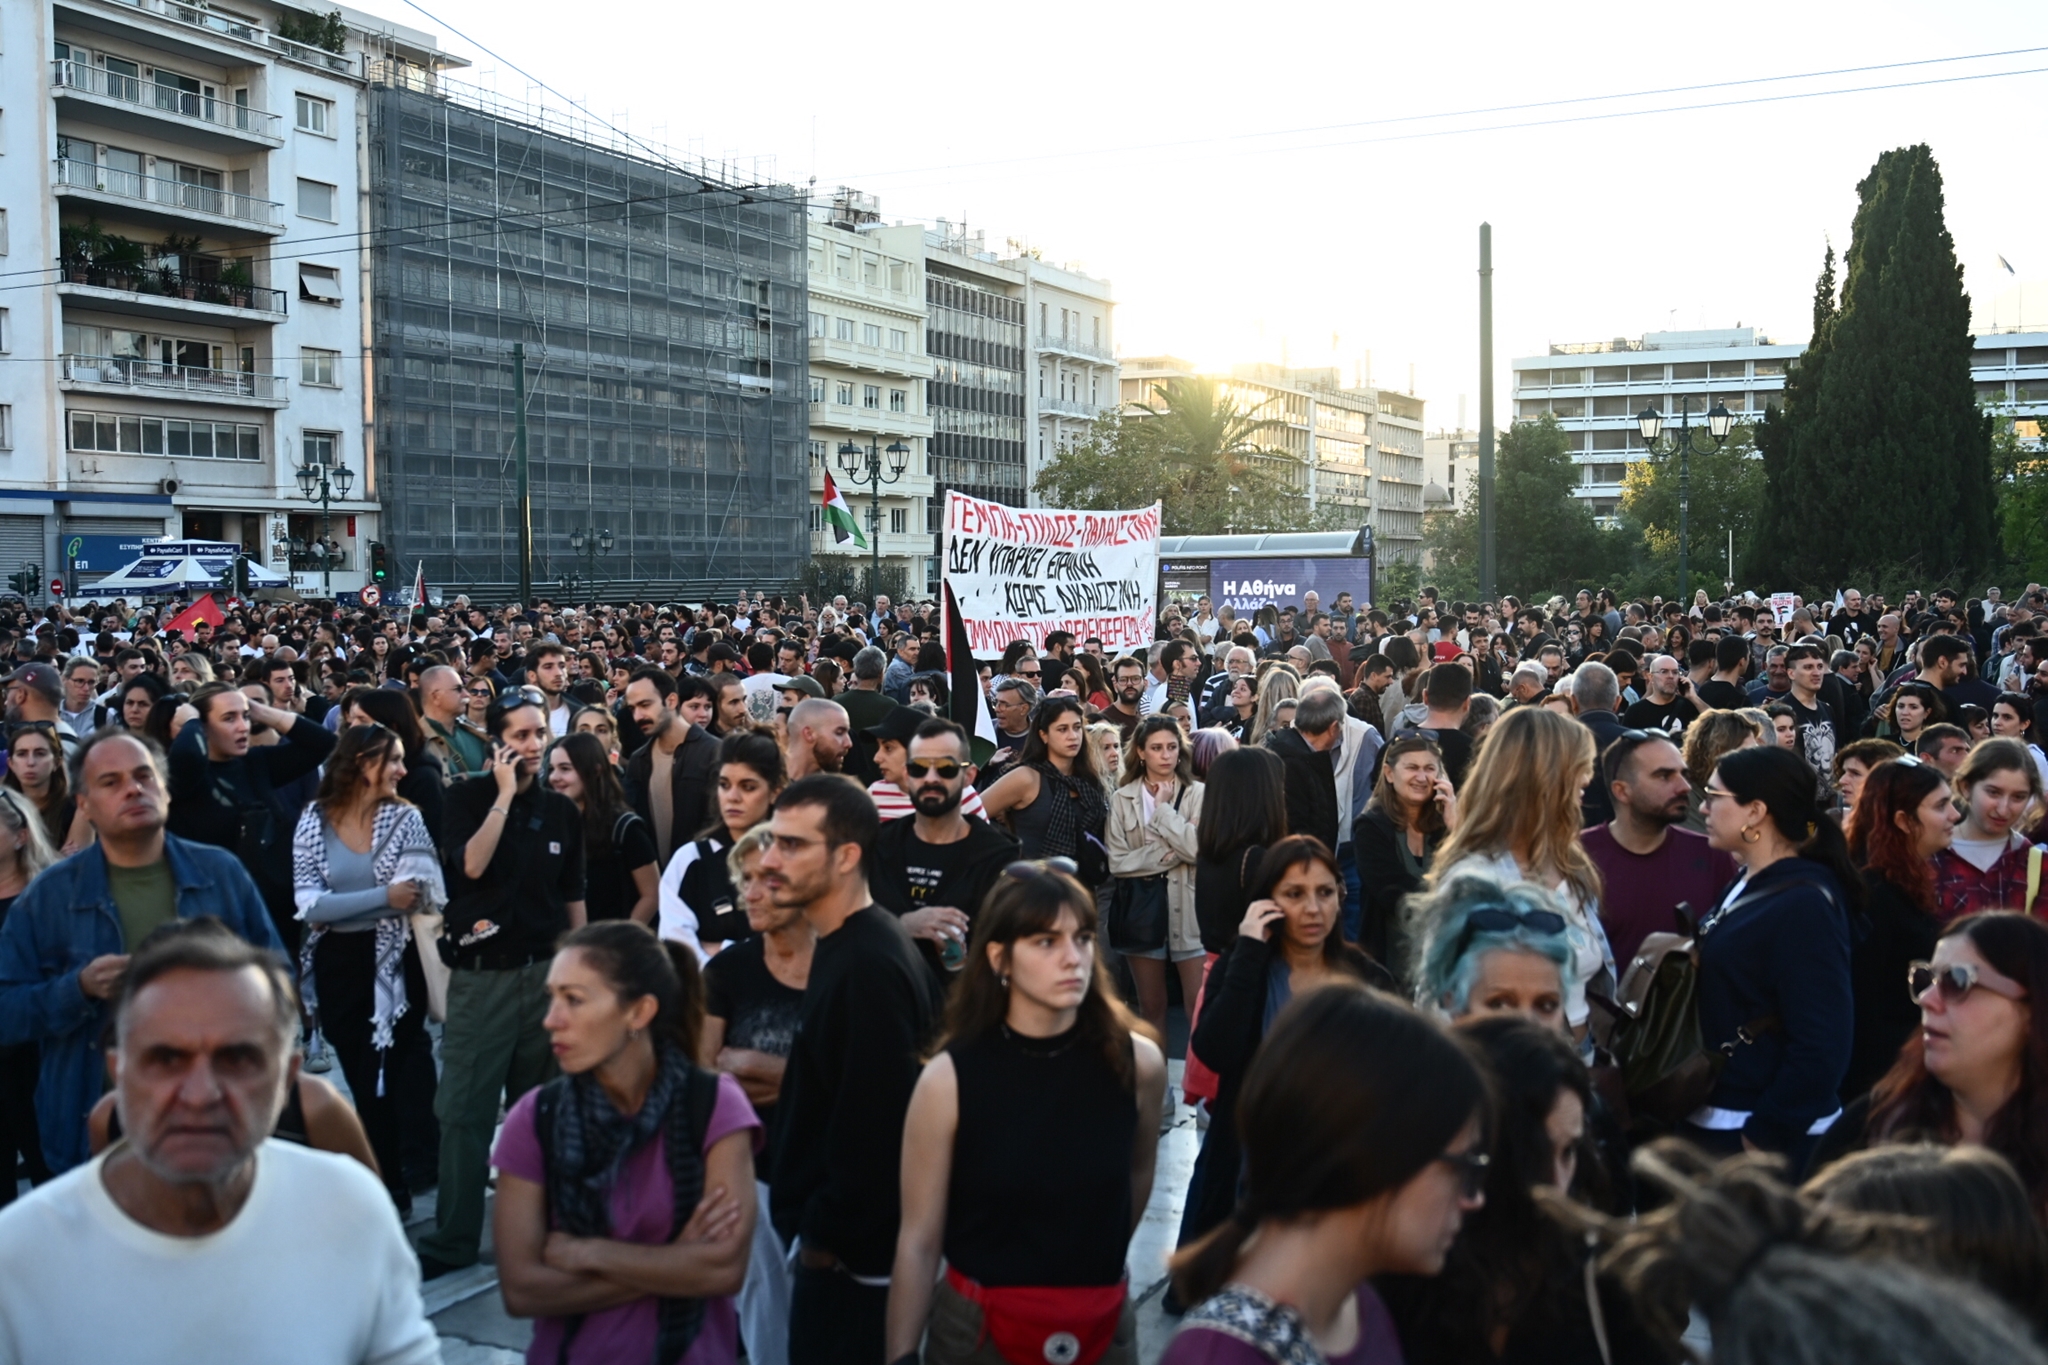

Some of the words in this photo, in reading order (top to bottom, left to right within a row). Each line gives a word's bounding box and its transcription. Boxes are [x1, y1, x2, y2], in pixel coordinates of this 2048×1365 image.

[156, 547, 183, 555] PaysafeCard
[204, 547, 234, 555] PaysafeCard
[949, 535, 988, 574] ΔΕΝ
[989, 542, 1048, 579] ΥΠΑΡΧΕΙ
[1047, 552, 1102, 581] ΕΙΡΗΝΗ
[74, 560, 89, 570] ΕΠ
[295, 587, 319, 595] urant
[1223, 580, 1237, 596] Η
[1239, 580, 1296, 598] Αθήνα
[1005, 581, 1057, 618] ΧΩΡΙΣ
[963, 619, 1057, 652] ΟΜΜΟΥΝΙΣΤΙΚ
